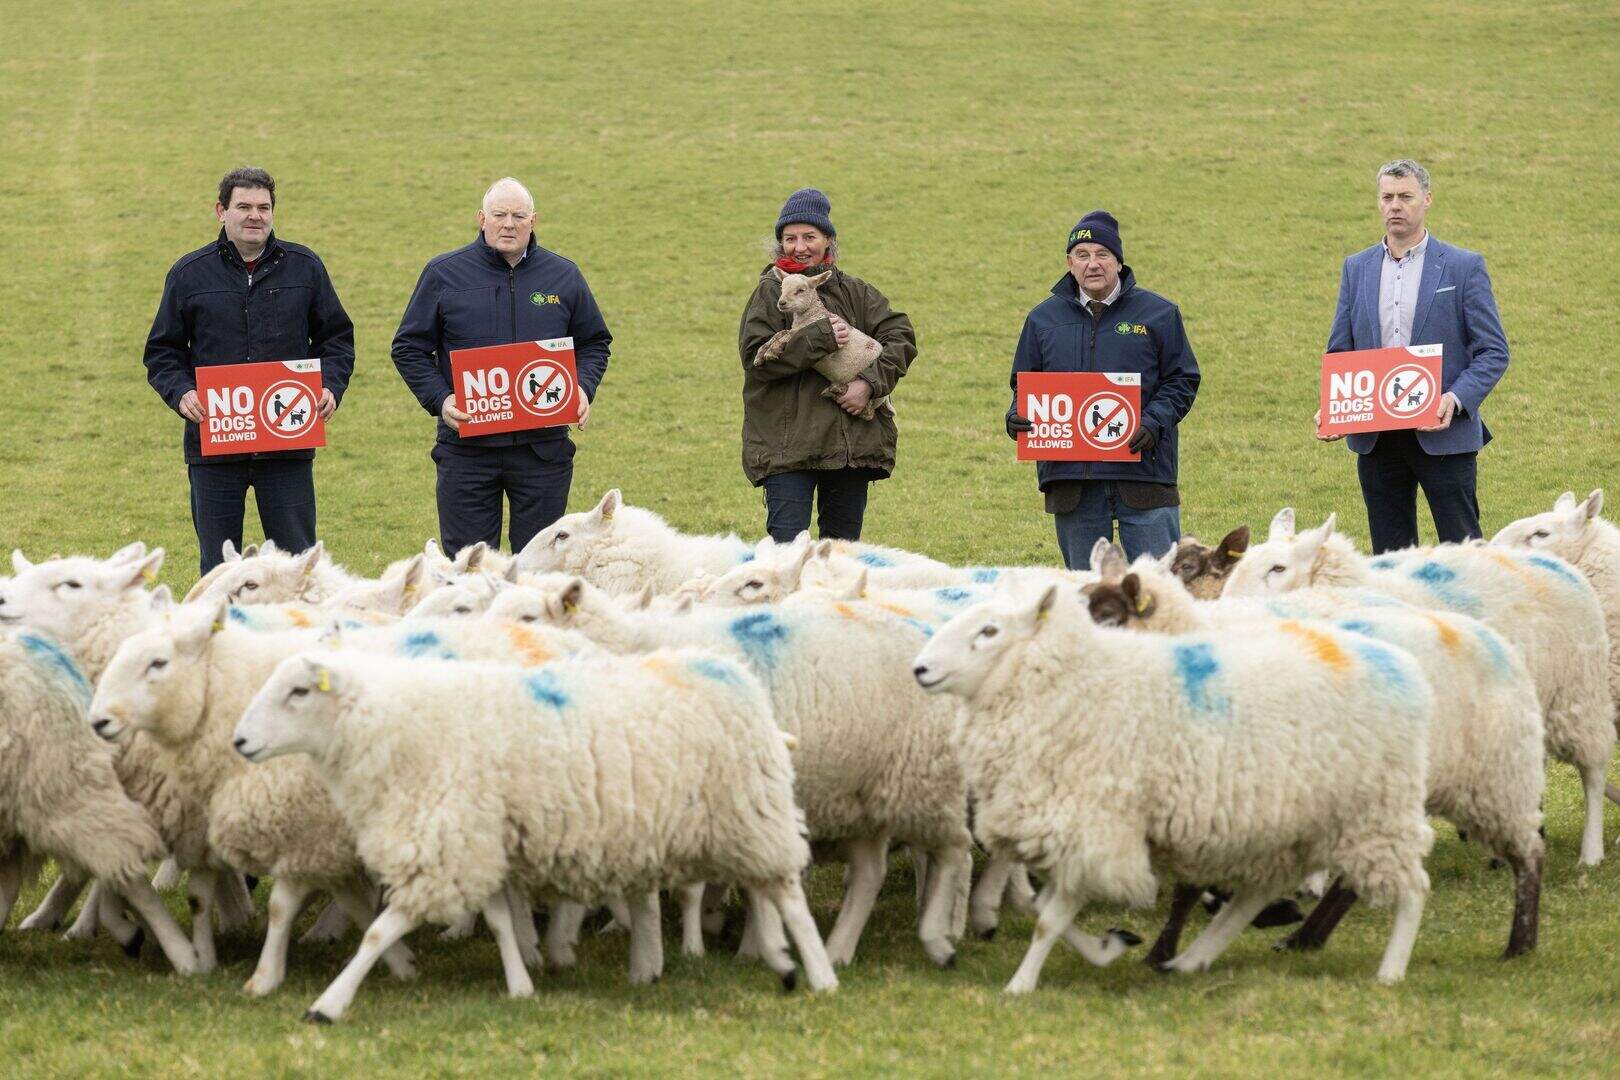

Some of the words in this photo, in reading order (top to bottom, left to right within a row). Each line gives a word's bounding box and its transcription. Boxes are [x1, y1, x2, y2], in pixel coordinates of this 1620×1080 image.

[1077, 229, 1092, 239] IFA
[547, 294, 560, 304] IFA
[1133, 324, 1147, 335] IFA
[462, 366, 510, 399] NO
[1330, 369, 1375, 400] NO
[207, 386, 255, 417] NO
[466, 395, 512, 414] DOGS
[1027, 393, 1073, 423] NO
[1329, 397, 1374, 415] DOGS
[209, 414, 256, 433] DOGS
[468, 410, 513, 424] ALLOWED
[1329, 412, 1374, 424] ALLOWED
[210, 431, 257, 443] ALLOWED
[1027, 423, 1073, 438] DOGS
[1027, 439, 1073, 449] ALLOWED
